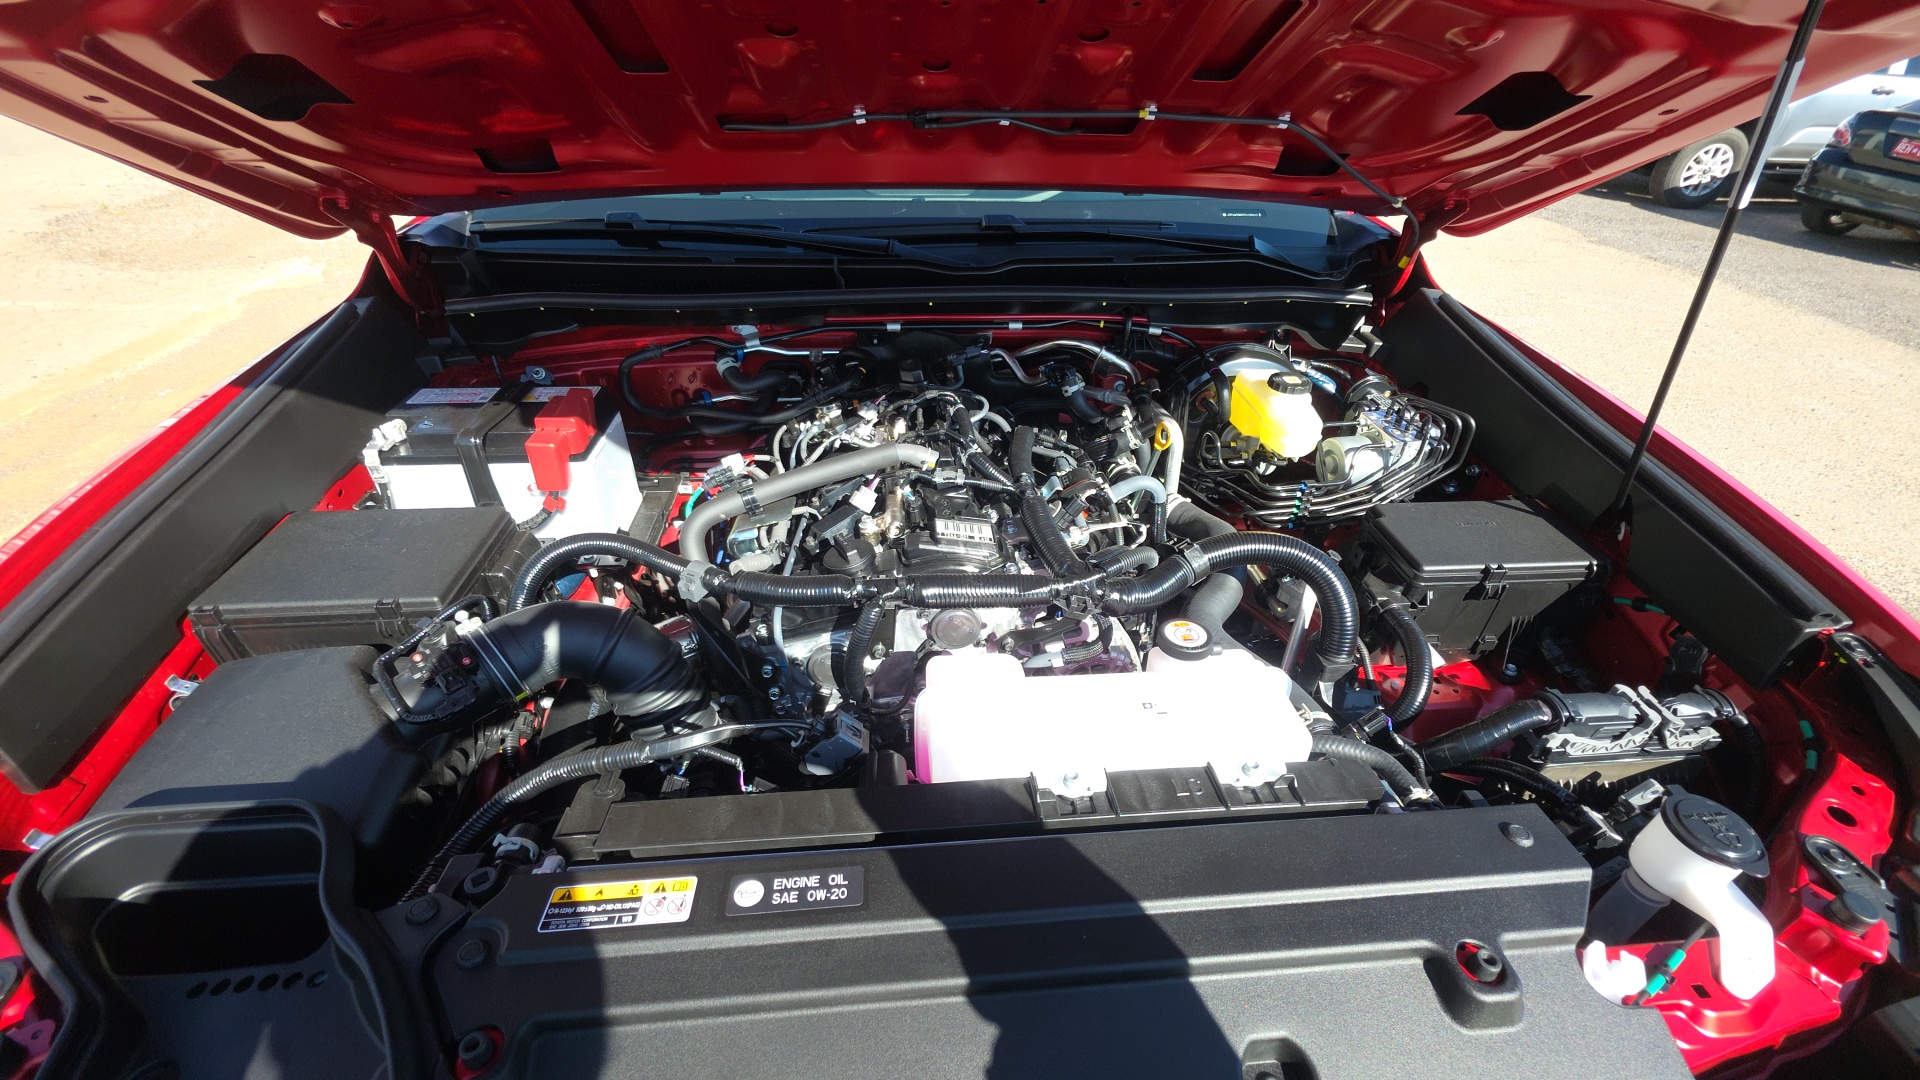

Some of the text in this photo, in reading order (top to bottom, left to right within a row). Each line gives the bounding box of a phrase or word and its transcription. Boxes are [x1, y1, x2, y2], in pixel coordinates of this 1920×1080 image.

[773, 873, 849, 890] ENGINE OIL
[771, 887, 848, 905] SAE 0W-20
